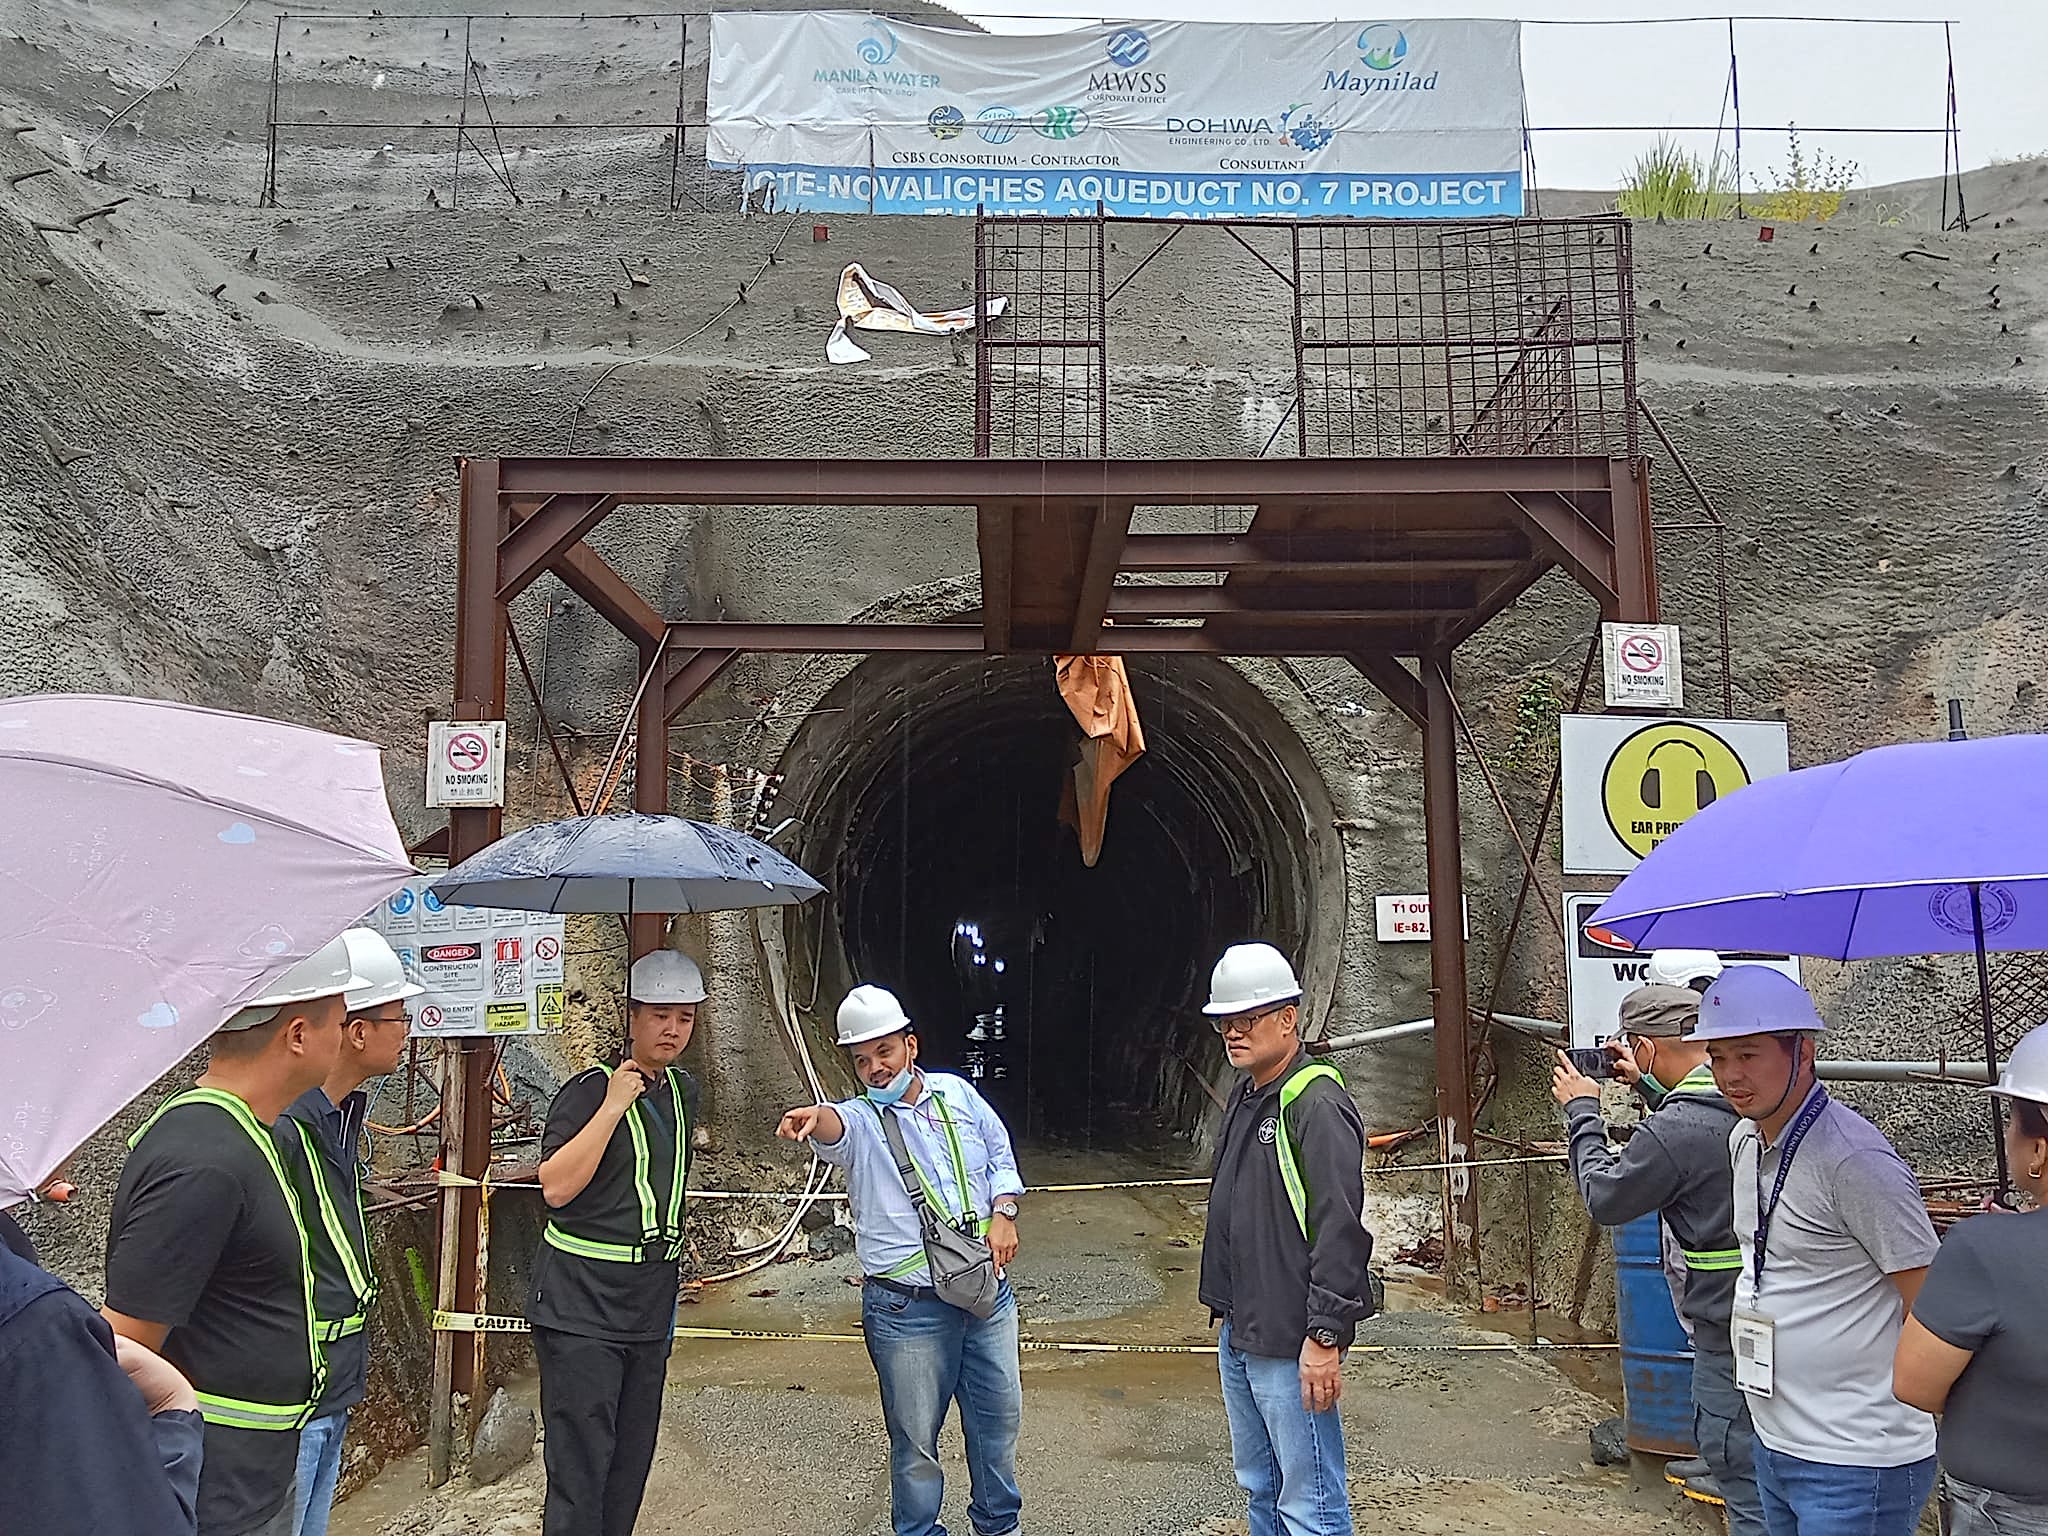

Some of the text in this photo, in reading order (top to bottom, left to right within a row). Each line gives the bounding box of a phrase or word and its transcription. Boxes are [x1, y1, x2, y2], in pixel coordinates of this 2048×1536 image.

[813, 69, 941, 88] MANILA WATER
[1088, 72, 1167, 94] MWSS
[1321, 69, 1439, 96] Maynilad
[1166, 117, 1274, 134] DOHWA
[1169, 137, 1232, 146] ENGINEERING
[892, 151, 926, 164] CSBS
[1055, 176, 1241, 206] AQUEDUCT
[1251, 181, 1310, 206] NO.
[1319, 182, 1340, 205] 7
[1350, 180, 1507, 206] PROJECT
[1622, 674, 1664, 686] NO SMOKING
[445, 773, 489, 785] NO SMOKING
[1631, 821, 1684, 835] EAR PRO
[1392, 903, 1405, 914] T1
[433, 948, 470, 957] DANGER
[423, 963, 479, 972] CONSTRUCTION
